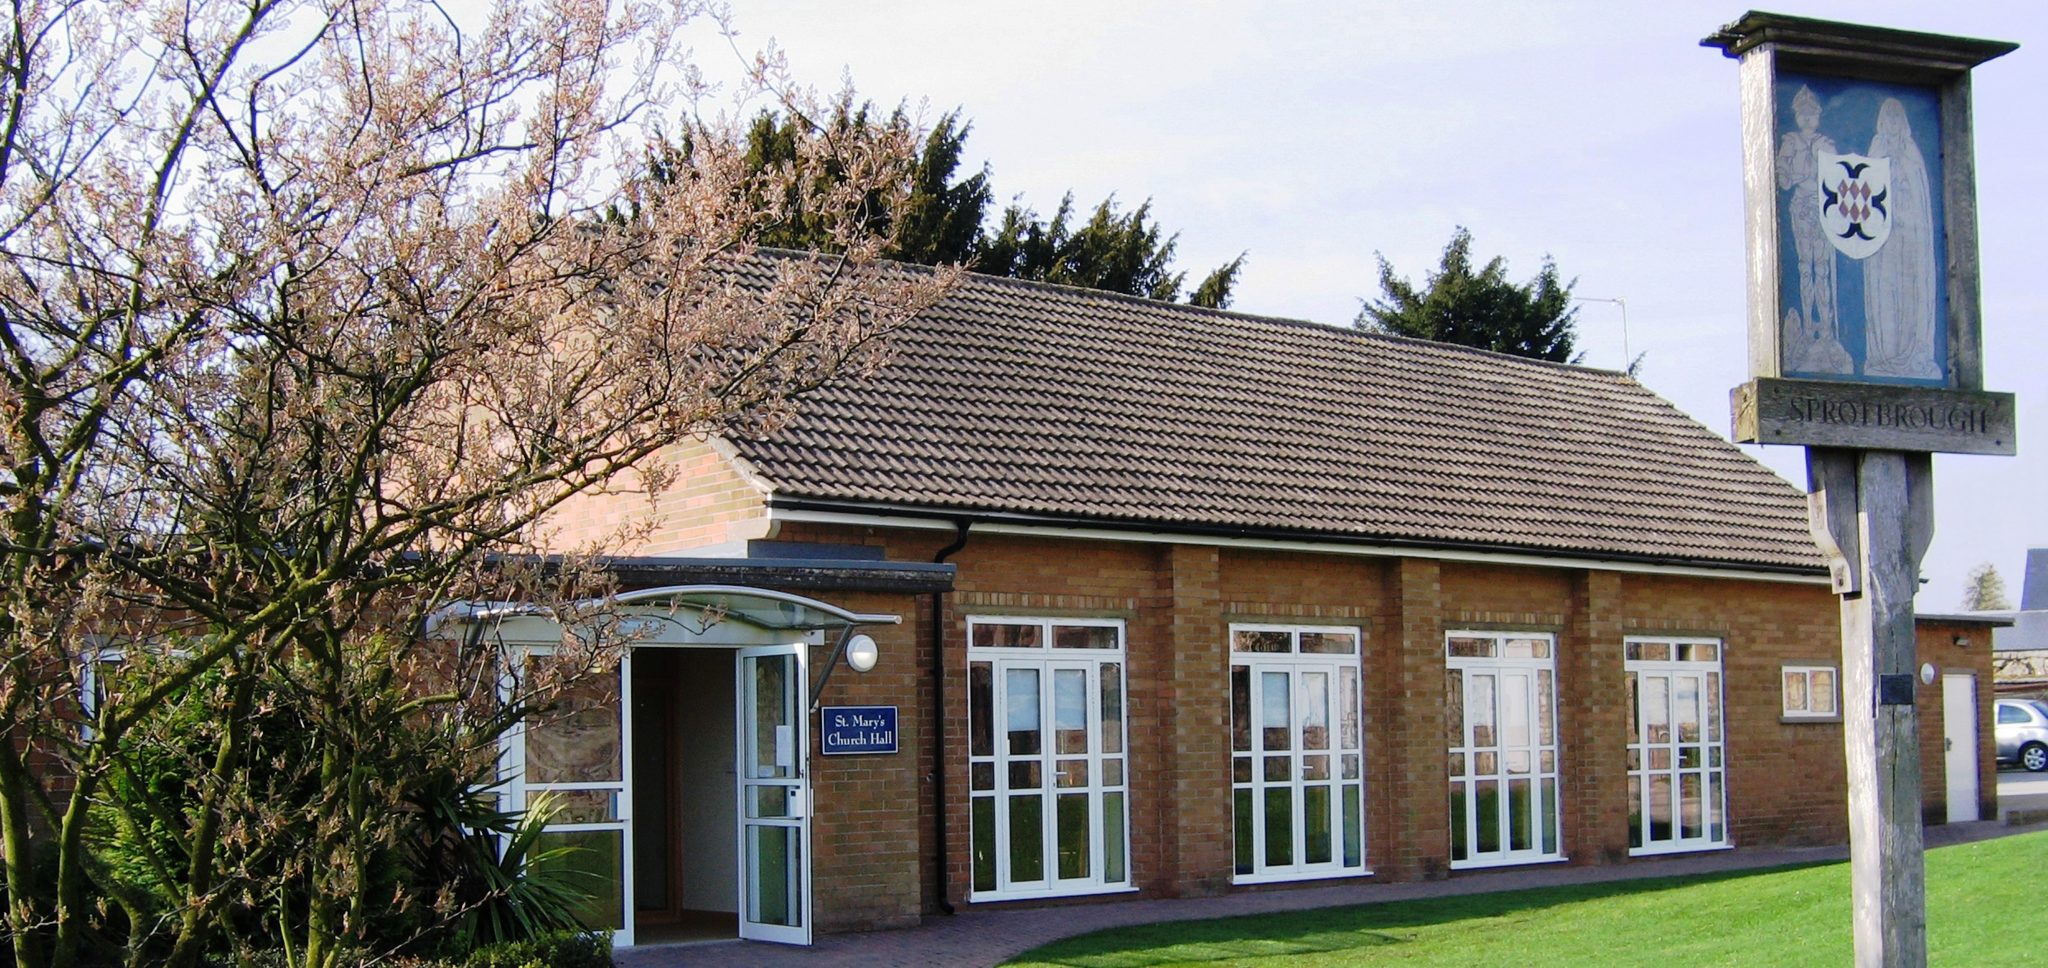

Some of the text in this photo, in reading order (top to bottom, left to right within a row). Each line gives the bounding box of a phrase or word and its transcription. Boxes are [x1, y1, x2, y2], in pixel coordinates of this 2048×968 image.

[1790, 398, 1988, 433] SPROTBROUGH
[835, 715, 885, 730] St. Mary's
[828, 730, 892, 746] Church Hall
